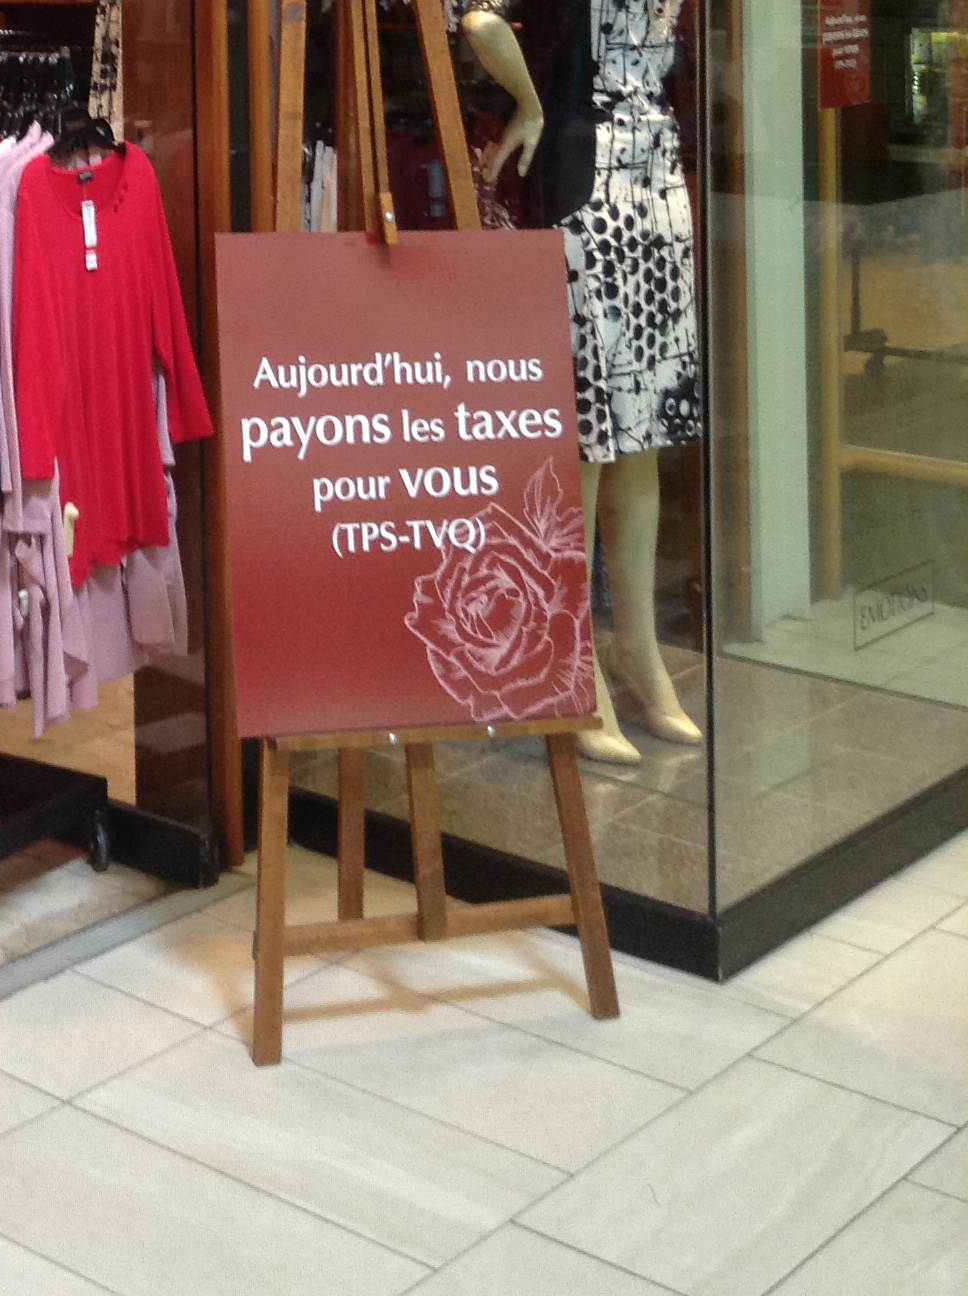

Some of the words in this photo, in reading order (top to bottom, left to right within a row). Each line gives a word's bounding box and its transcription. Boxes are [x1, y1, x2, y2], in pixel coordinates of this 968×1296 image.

[253, 351, 453, 399] Aujourd'hui,
[466, 357, 543, 383] nous
[240, 412, 392, 463] payons
[401, 409, 445, 443] les
[454, 402, 564, 442] taxes
[312, 475, 391, 513] pour
[398, 464, 499, 498] vous
[331, 517, 487, 559] (TPS-TVQ)
